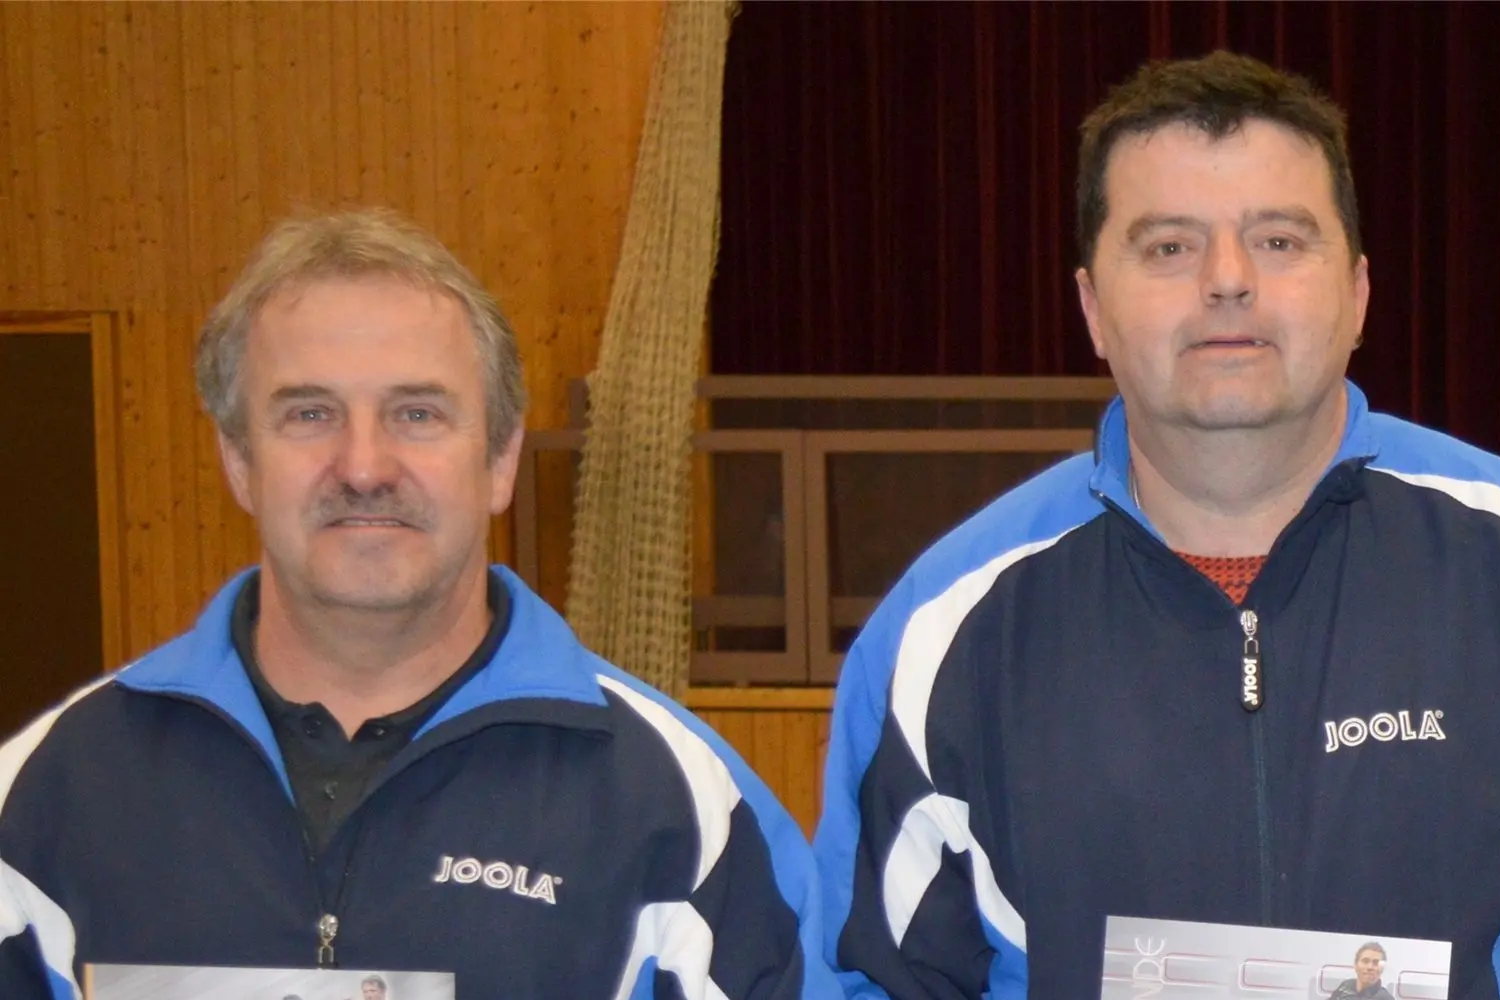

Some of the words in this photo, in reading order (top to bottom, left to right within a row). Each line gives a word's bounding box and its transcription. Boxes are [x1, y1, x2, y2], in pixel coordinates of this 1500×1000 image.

[1243, 657, 1258, 706] JOOLA
[1323, 709, 1446, 754] JOOLA
[433, 855, 563, 905] JOOLA
